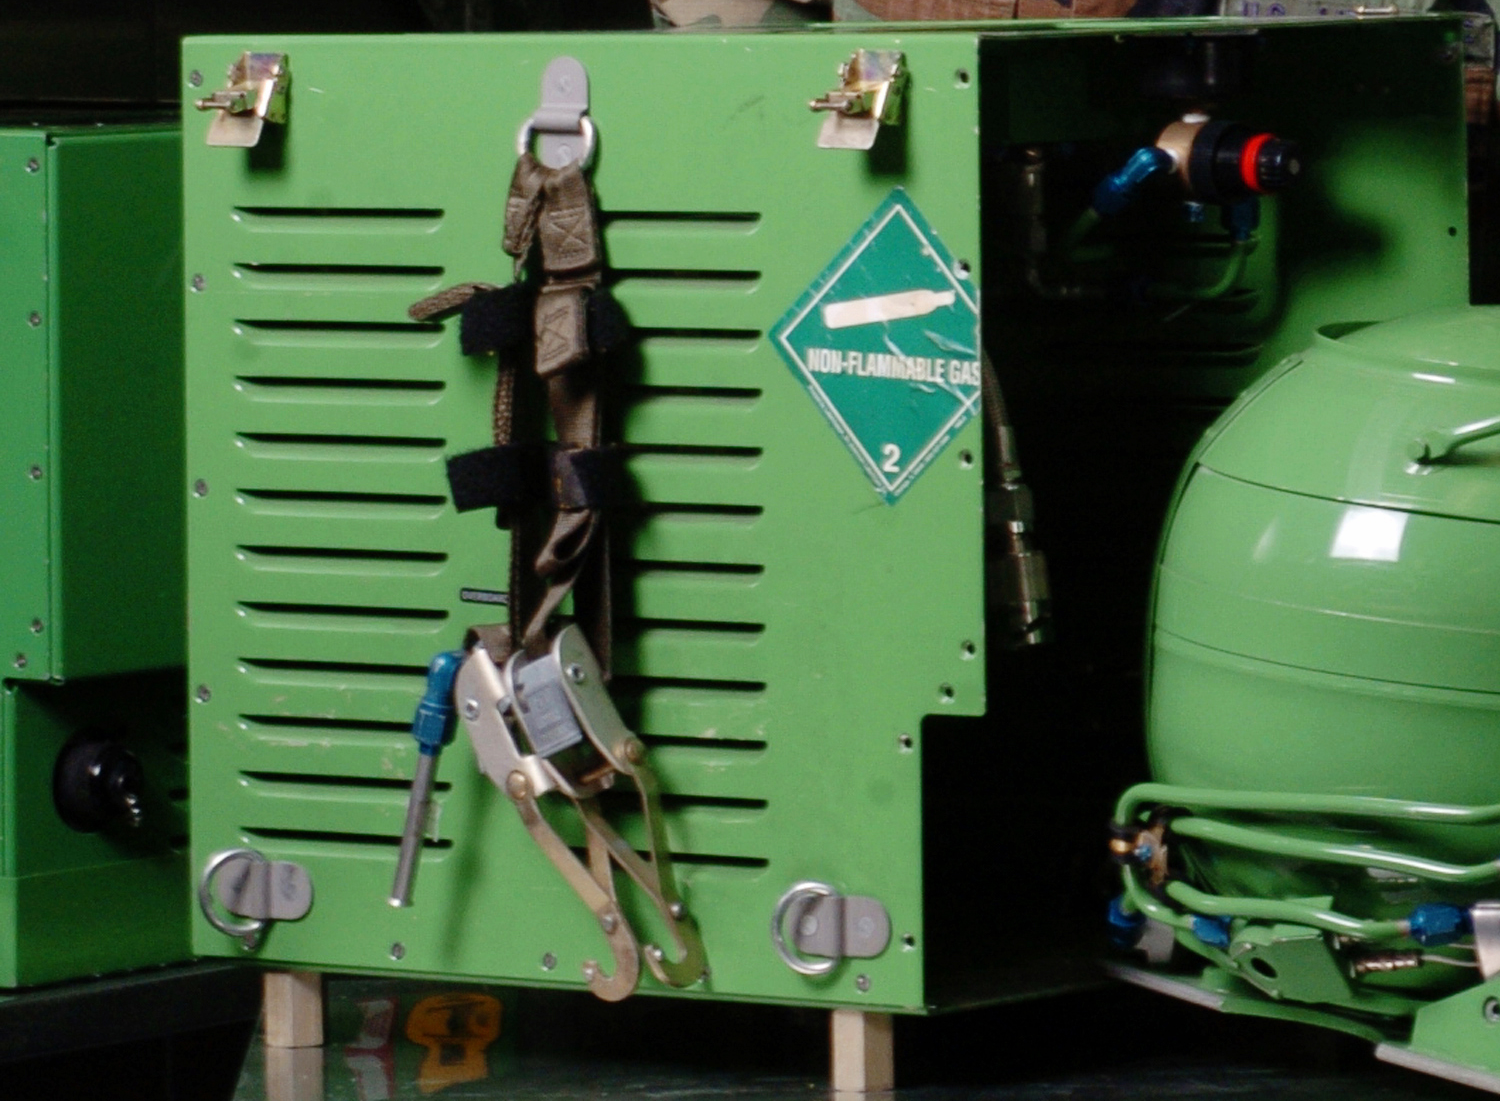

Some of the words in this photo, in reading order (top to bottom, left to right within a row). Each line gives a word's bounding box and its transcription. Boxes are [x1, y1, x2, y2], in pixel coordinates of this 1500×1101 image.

[807, 348, 946, 384] NON-FLAMMABLE
[949, 360, 981, 387] GAS
[881, 443, 901, 473] 2
